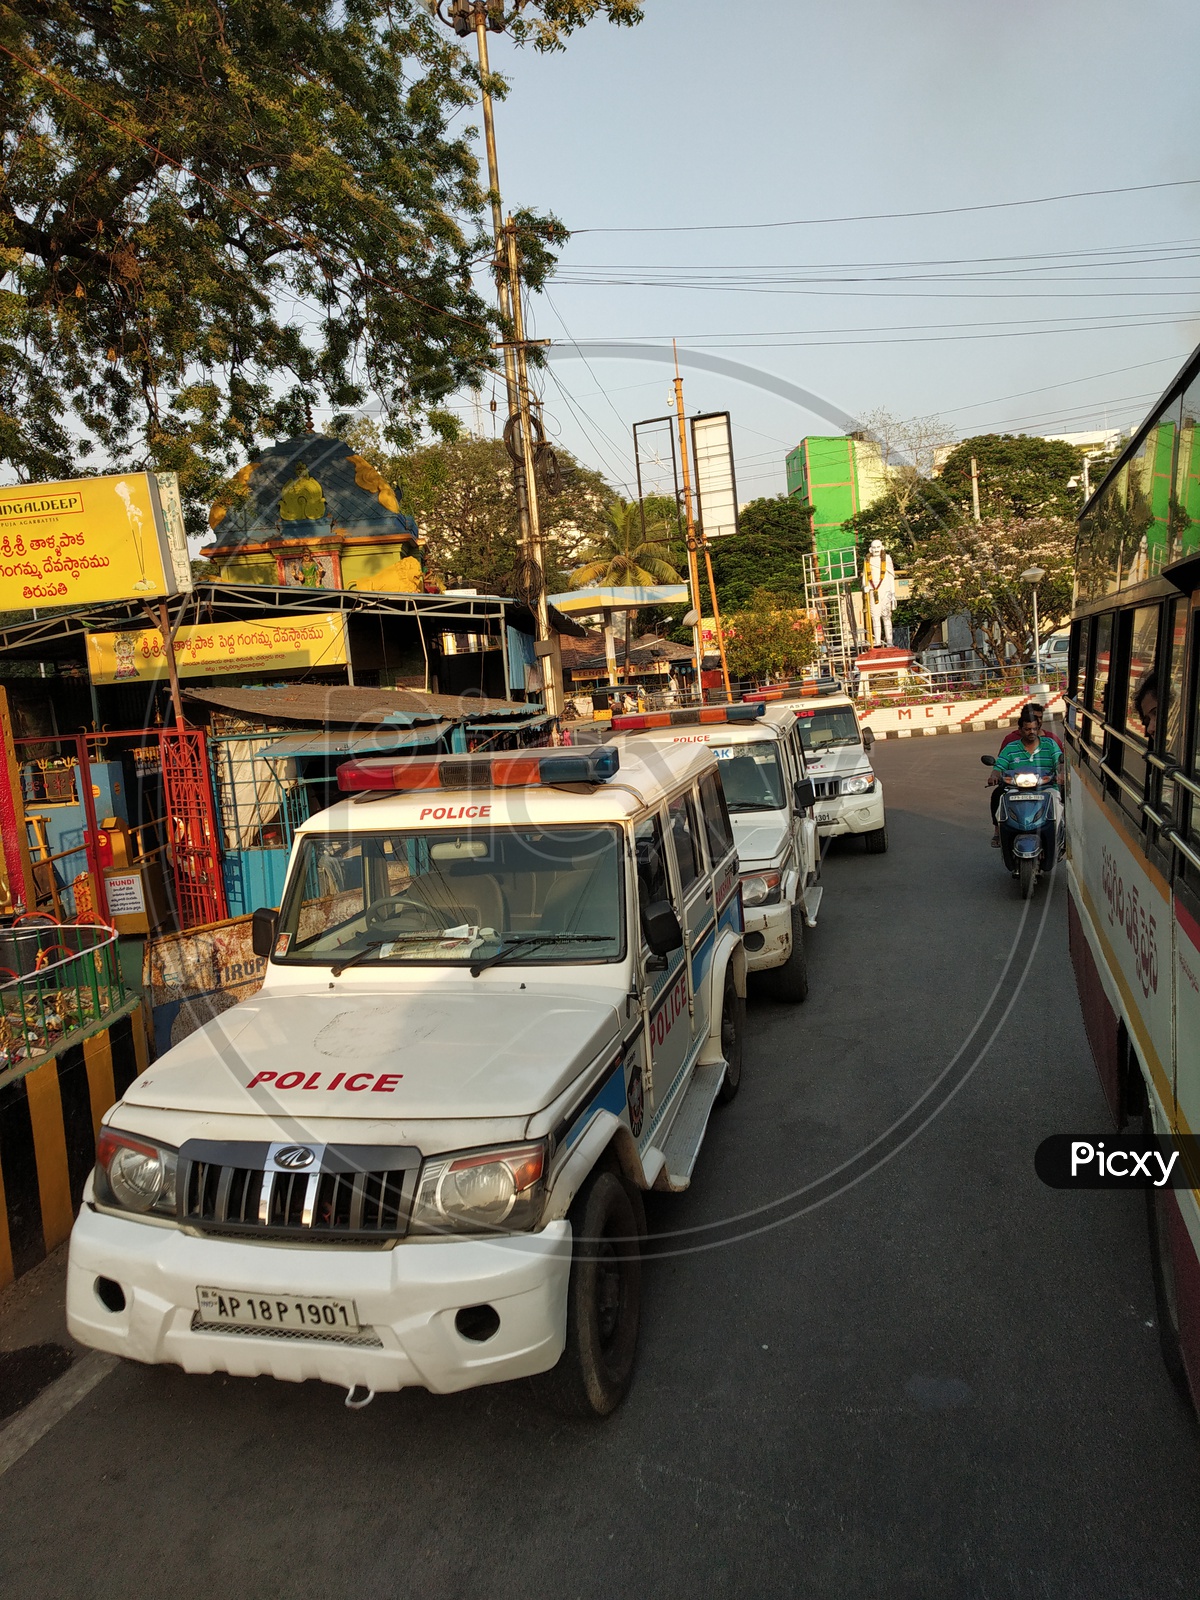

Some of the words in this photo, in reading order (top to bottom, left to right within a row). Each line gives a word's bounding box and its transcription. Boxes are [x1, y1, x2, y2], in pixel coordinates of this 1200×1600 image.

[20, 517, 59, 526] AGARBATTIS
[22, 582, 68, 599] తిరుపతి
[219, 635, 236, 655] పెద్ద
[237, 633, 273, 649] గంగమ్మ
[673, 735, 711, 743] POLICE
[420, 805, 492, 821] POLICE
[109, 878, 135, 888] HUNDI
[650, 975, 687, 1060] POLICE
[246, 1071, 404, 1092] POLICE
[218, 1295, 241, 1318] AP
[295, 1302, 349, 1327] 1901
